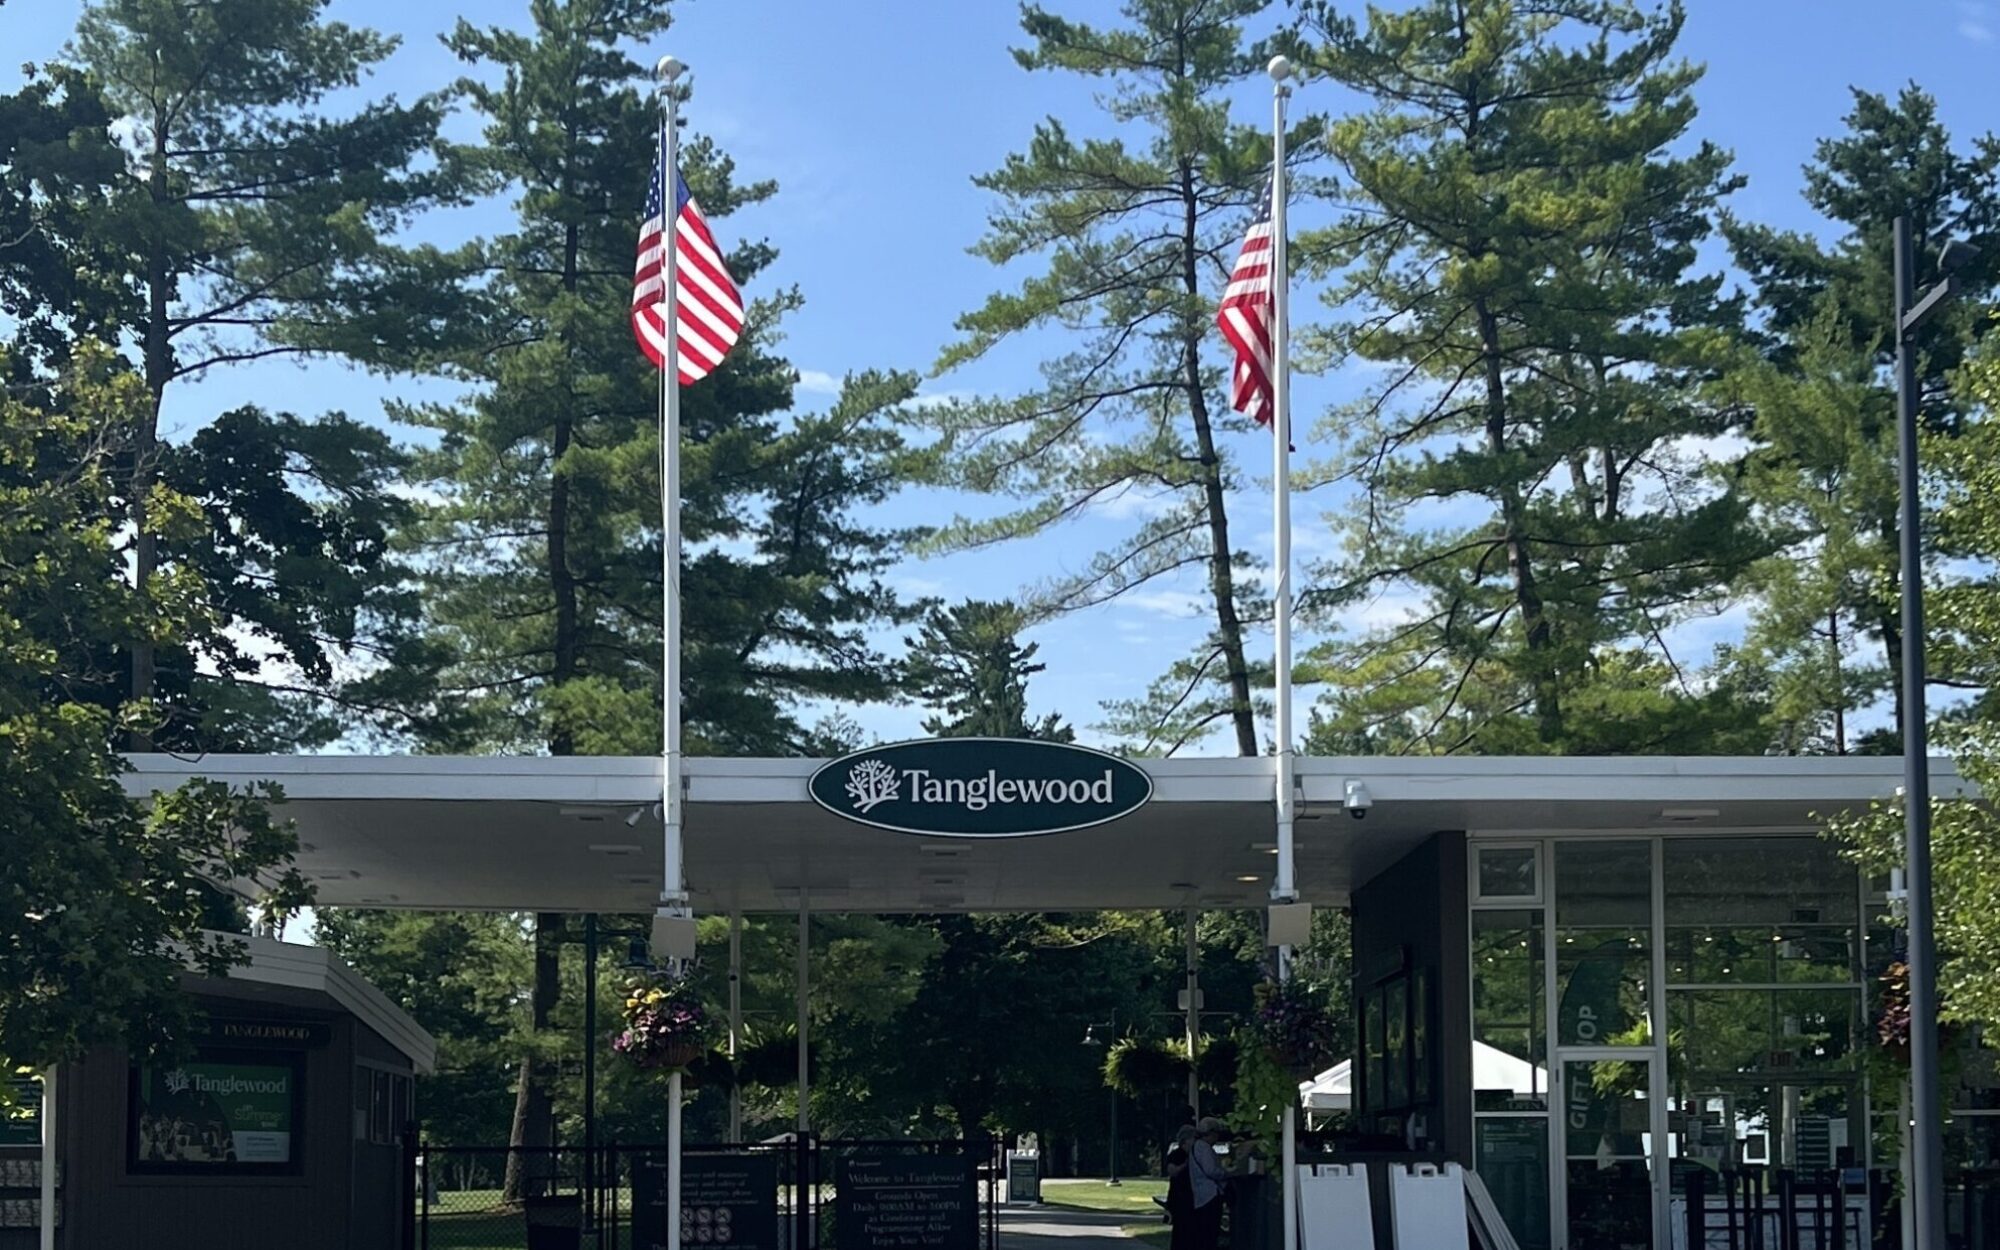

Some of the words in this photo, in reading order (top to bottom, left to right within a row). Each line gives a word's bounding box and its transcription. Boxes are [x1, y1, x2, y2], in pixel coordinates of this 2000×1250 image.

[902, 769, 1113, 811] Tanglewood
[224, 1024, 310, 1040] TANGLEWOOD
[192, 1074, 286, 1096] Tanglewood
[1569, 1076, 1590, 1130] GIFT
[848, 1172, 890, 1184] Welcome
[894, 1174, 905, 1183] to
[908, 1171, 965, 1184] Tanglewood
[875, 1191, 912, 1201] Grounds
[914, 1190, 939, 1202] Open
[853, 1202, 875, 1213] Daily
[929, 1211, 946, 1221] and
